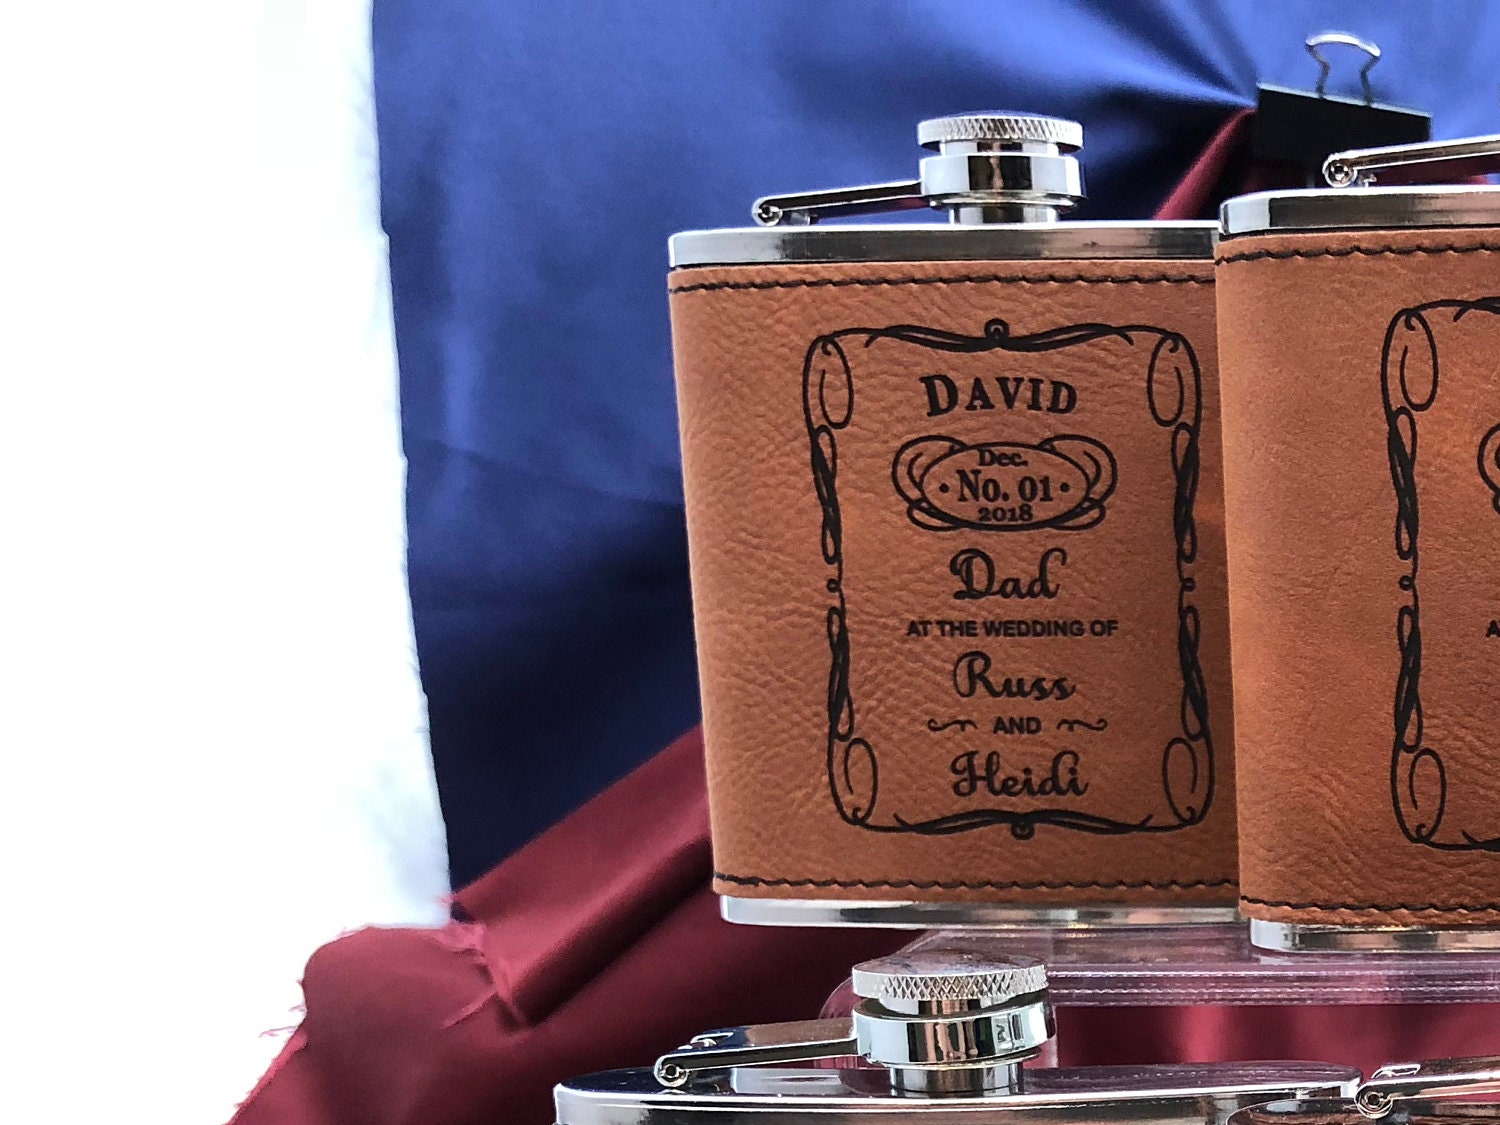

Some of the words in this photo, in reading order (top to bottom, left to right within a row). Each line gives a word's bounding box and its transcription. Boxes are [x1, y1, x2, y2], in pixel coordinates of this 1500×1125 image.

[919, 374, 1077, 417] DAVID
[978, 448, 1028, 467] Dec.
[957, 470, 1009, 502] No.
[1018, 476, 1053, 502] 01
[978, 505, 1033, 522] 2018
[949, 547, 1067, 600] Dad
[906, 620, 932, 637] AT
[937, 620, 978, 637] THE
[983, 620, 1085, 637] WEDDING
[1091, 620, 1118, 636] OF
[952, 651, 1076, 701] Russ
[993, 717, 1041, 735] AND
[950, 750, 1089, 797] Heidi
